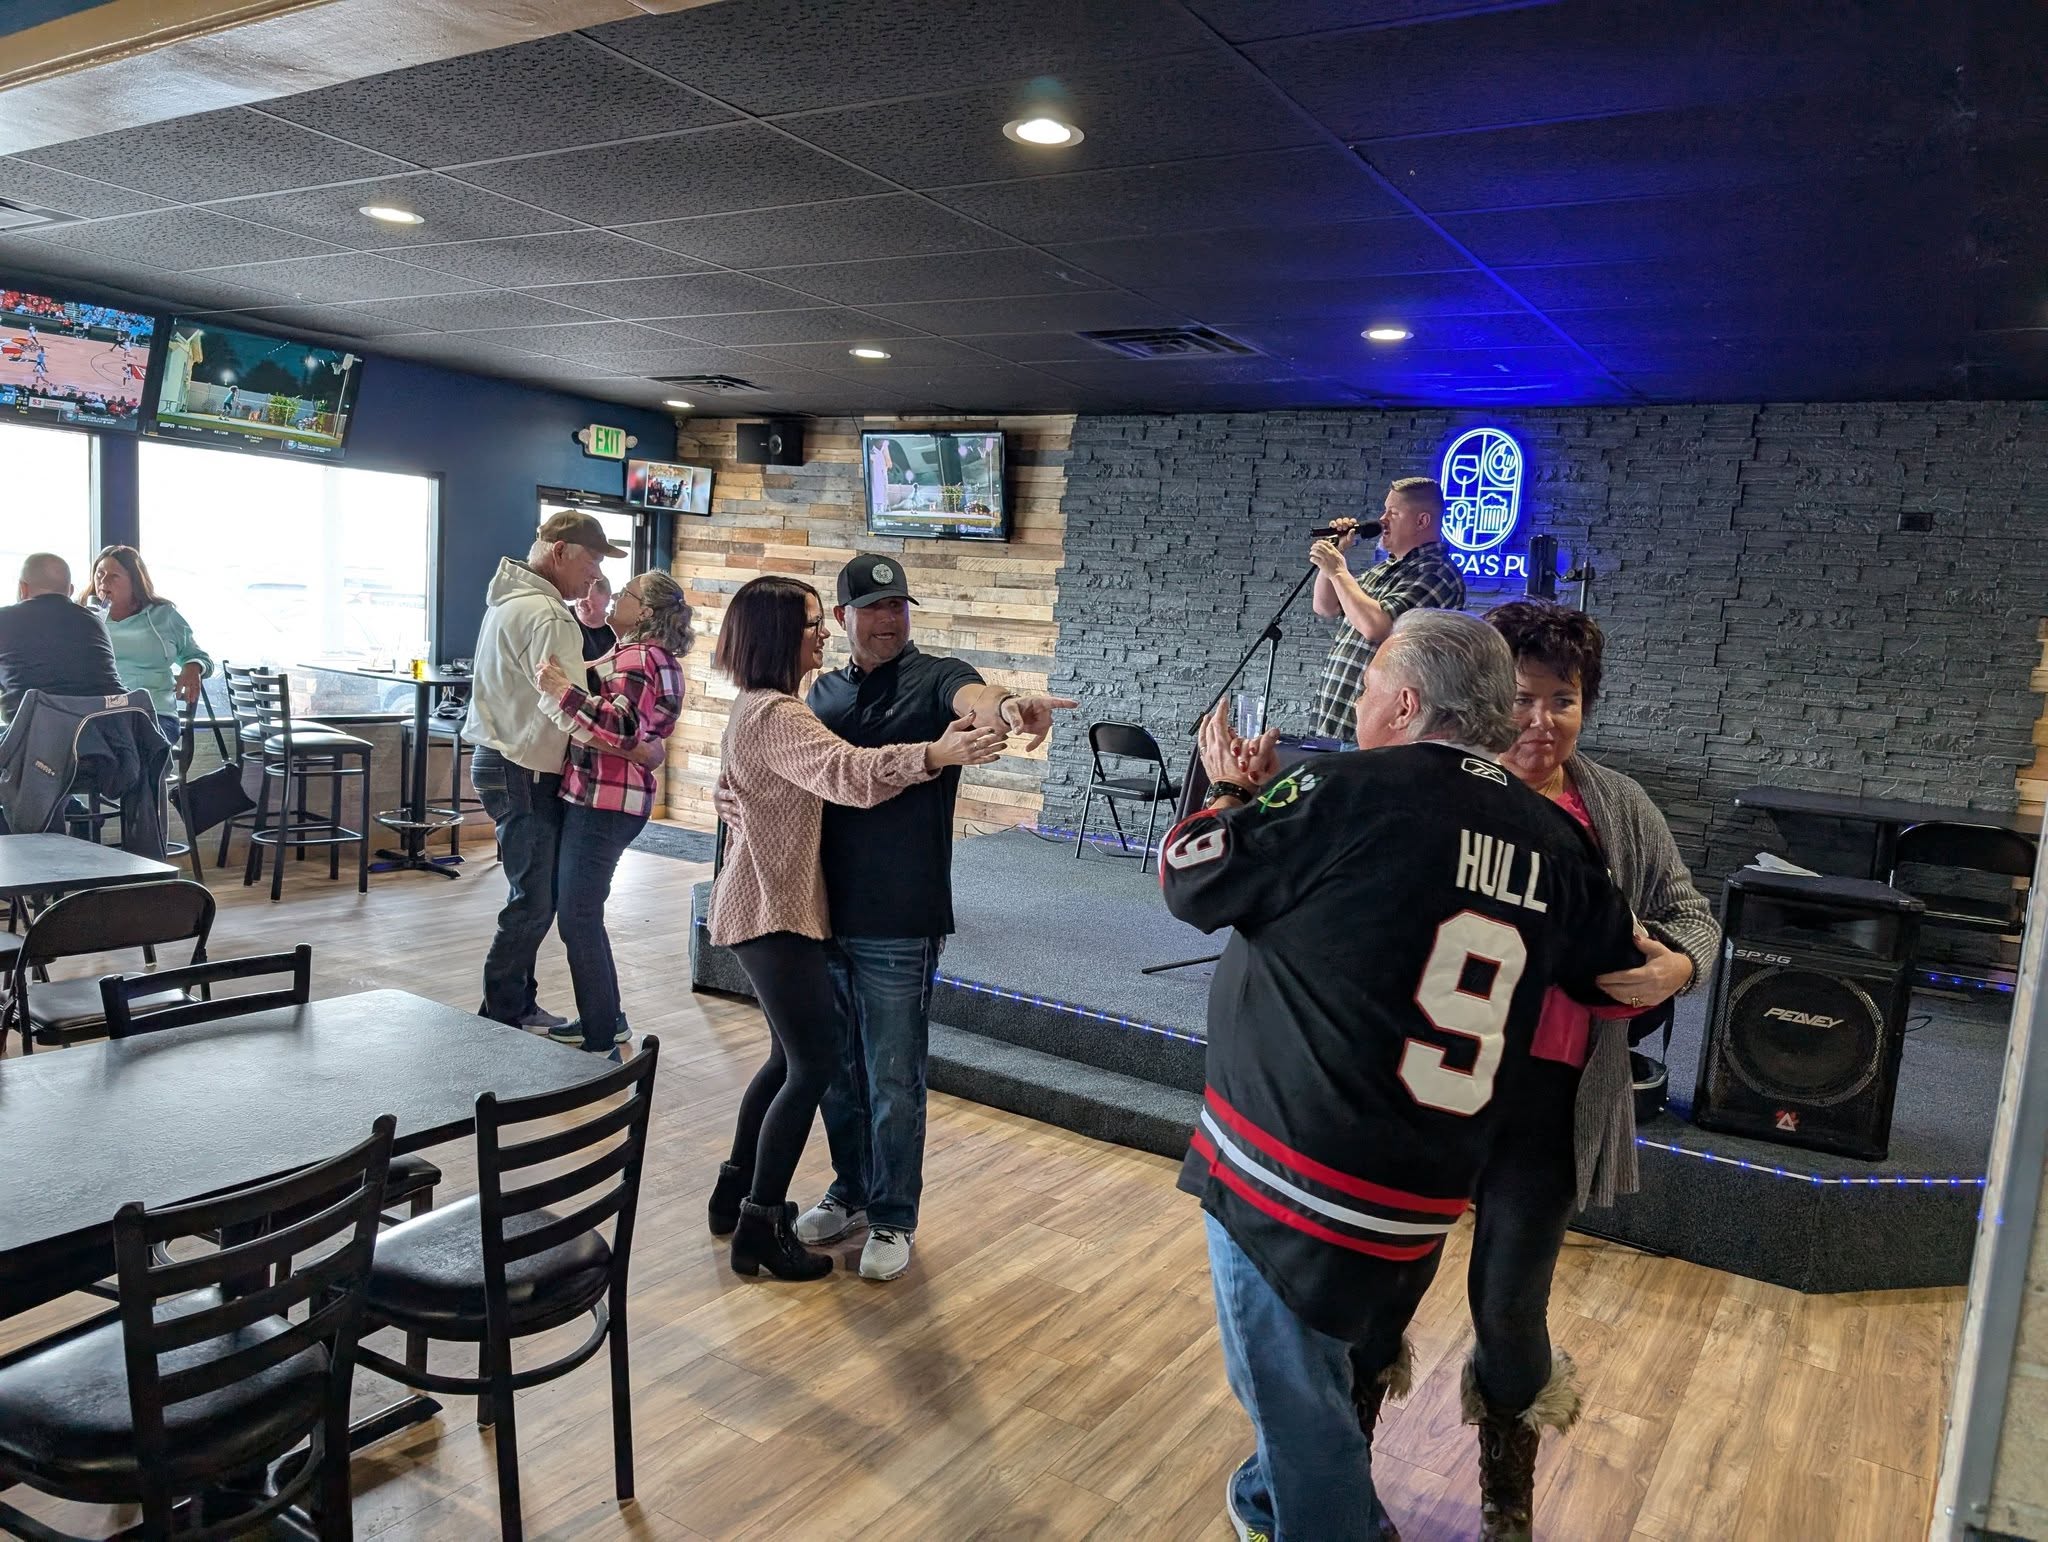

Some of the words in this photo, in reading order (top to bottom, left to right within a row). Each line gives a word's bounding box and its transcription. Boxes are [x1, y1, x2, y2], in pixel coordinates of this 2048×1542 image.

[595, 427, 621, 454] EXIT
[1166, 828, 1226, 870] 9
[1455, 829, 1547, 914] HULL
[1397, 908, 1528, 1117] 9
[1763, 1007, 1845, 1029] PEAVEY
